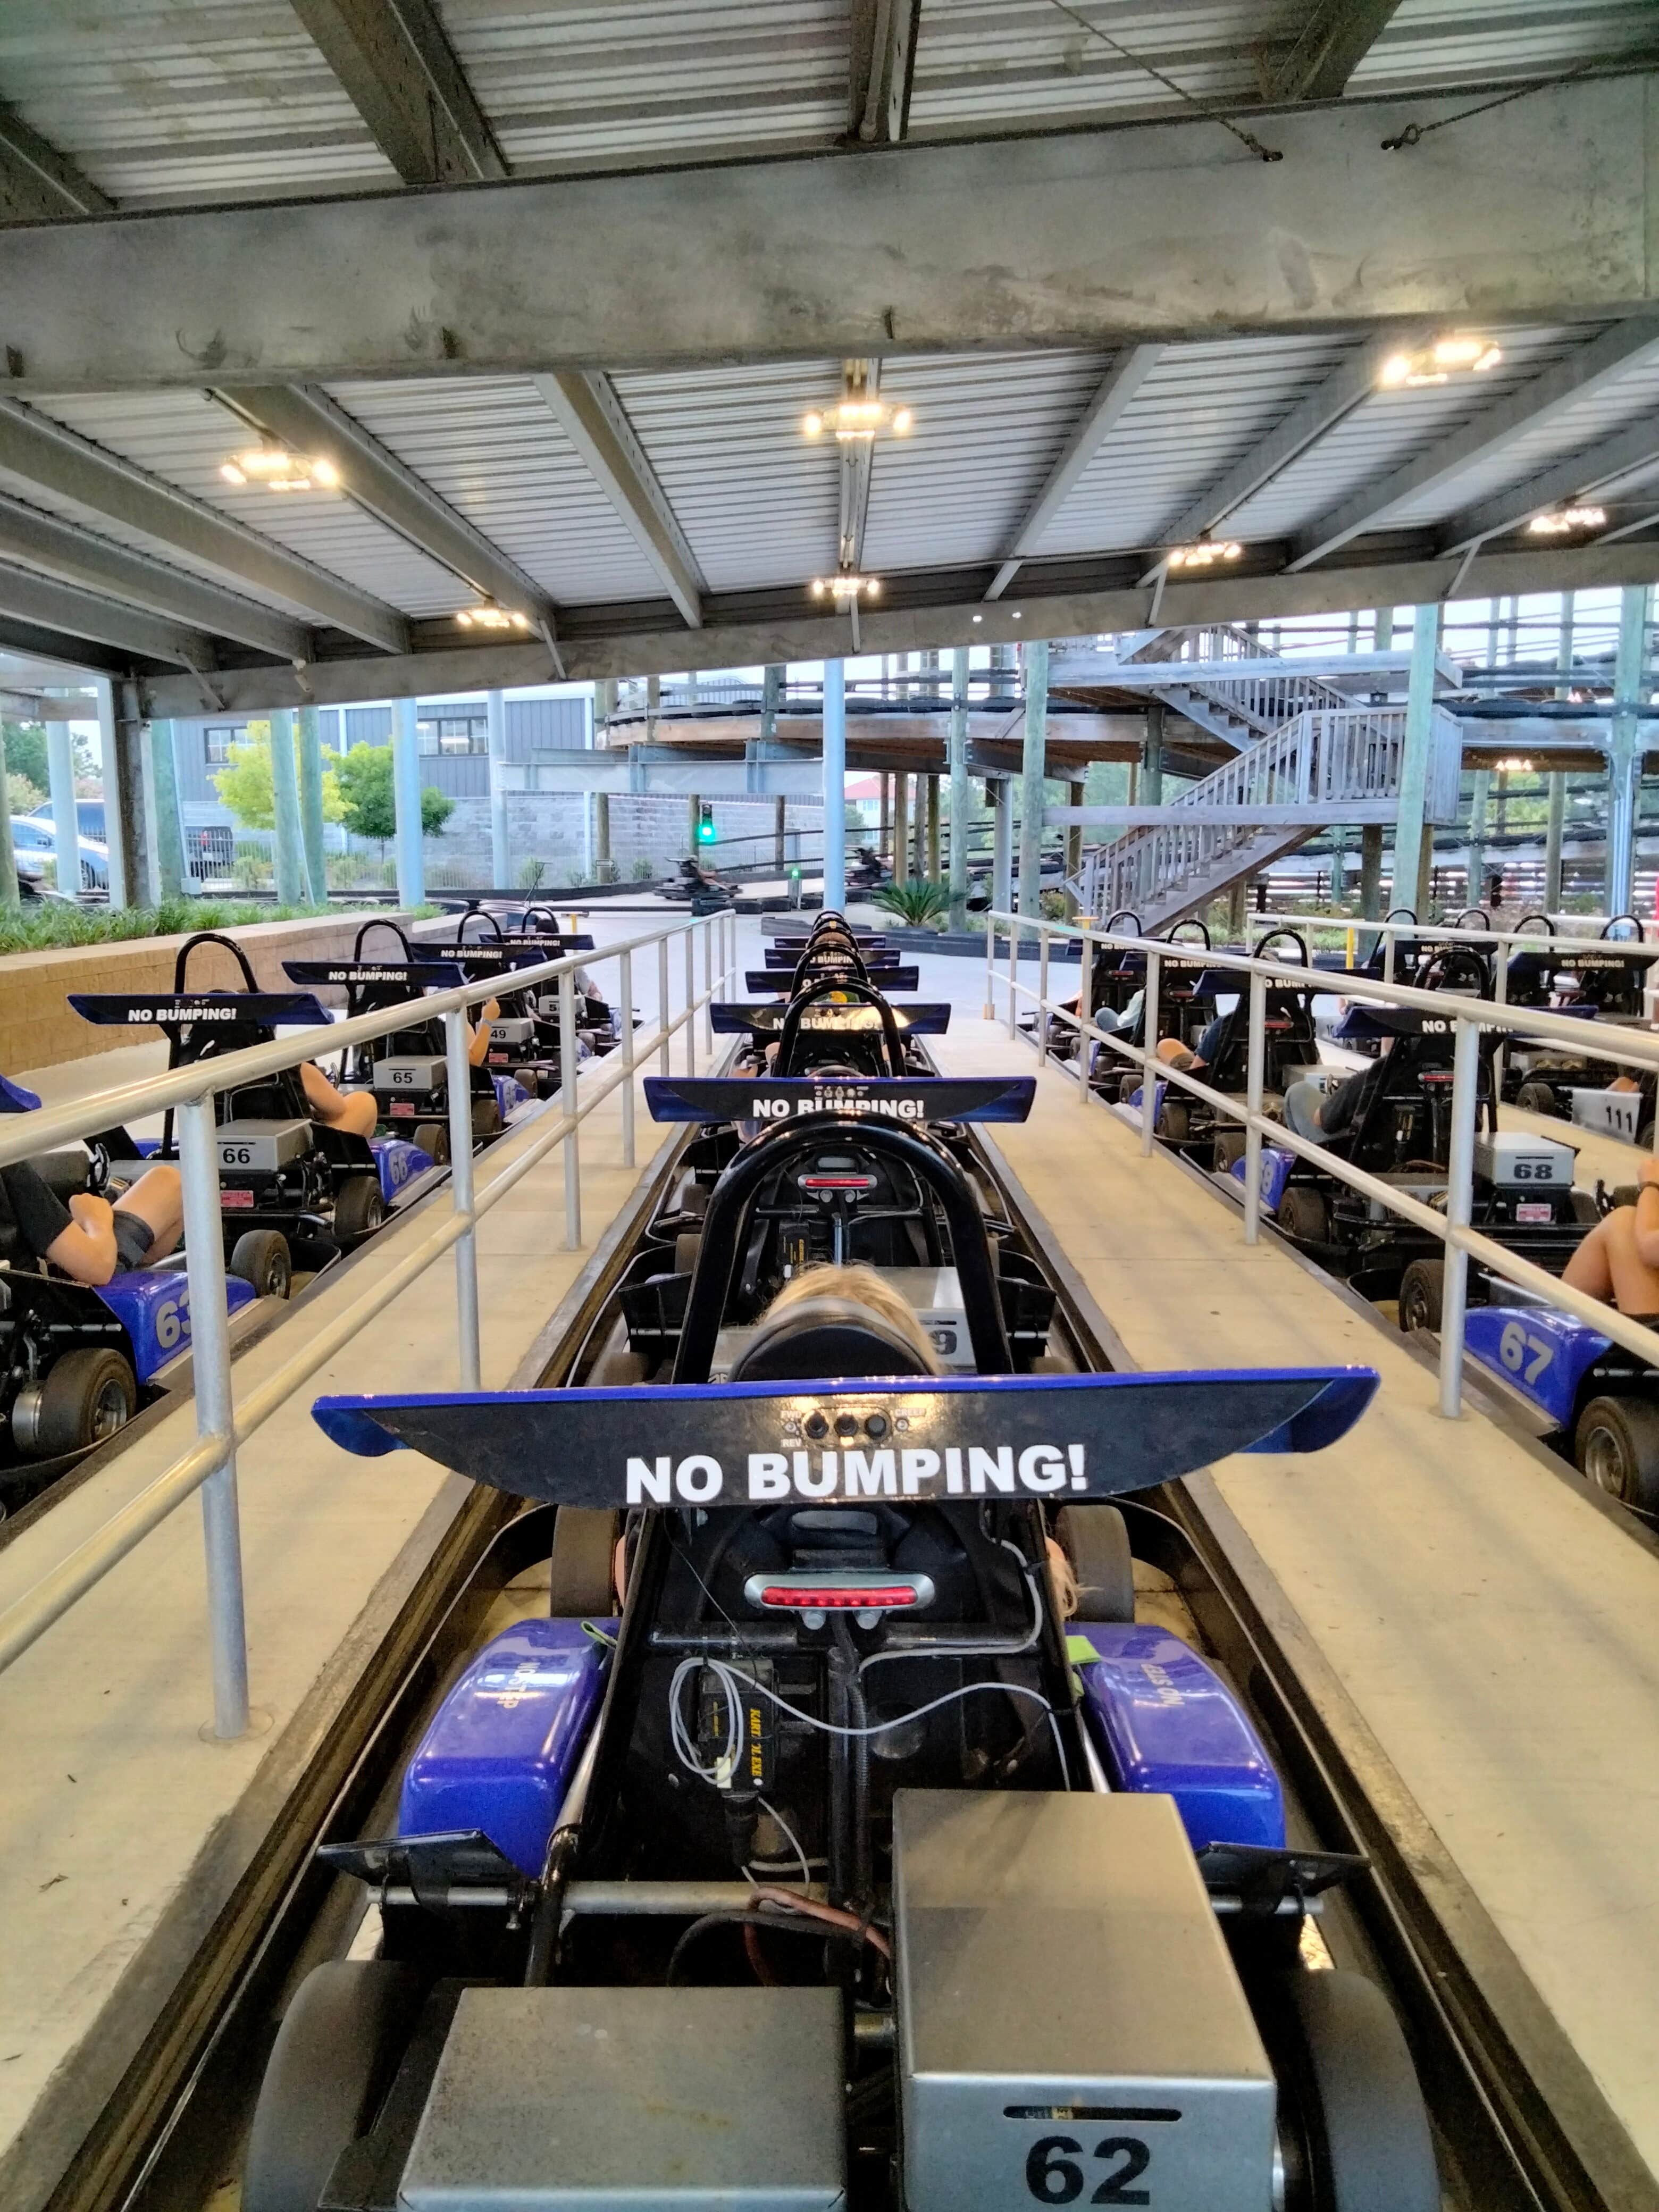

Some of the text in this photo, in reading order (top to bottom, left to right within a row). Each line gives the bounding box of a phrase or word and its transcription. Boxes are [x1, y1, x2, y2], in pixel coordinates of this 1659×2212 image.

[457, 950, 502, 959] BUMPING!
[1578, 959, 1624, 968] BUMPING!
[329, 971, 408, 981] NO BUMPING!
[128, 1008, 237, 1021] NO BUMPING!
[491, 1029, 506, 1038] 49
[1422, 1020, 1446, 1033] NO
[393, 1072, 413, 1084] 65
[753, 1099, 924, 1118] NO BUMPING!
[1606, 1105, 1632, 1134] 111
[223, 1148, 250, 1164] 66
[1514, 1163, 1553, 1179] 68
[1500, 1321, 1553, 1385] 67
[781, 1438, 802, 1447] REV
[626, 1444, 1088, 1504] NO BUMPING!
[496, 1677, 531, 1709] STP
[1157, 1687, 1185, 1705] NO
[1025, 2135, 1150, 2205] 62
